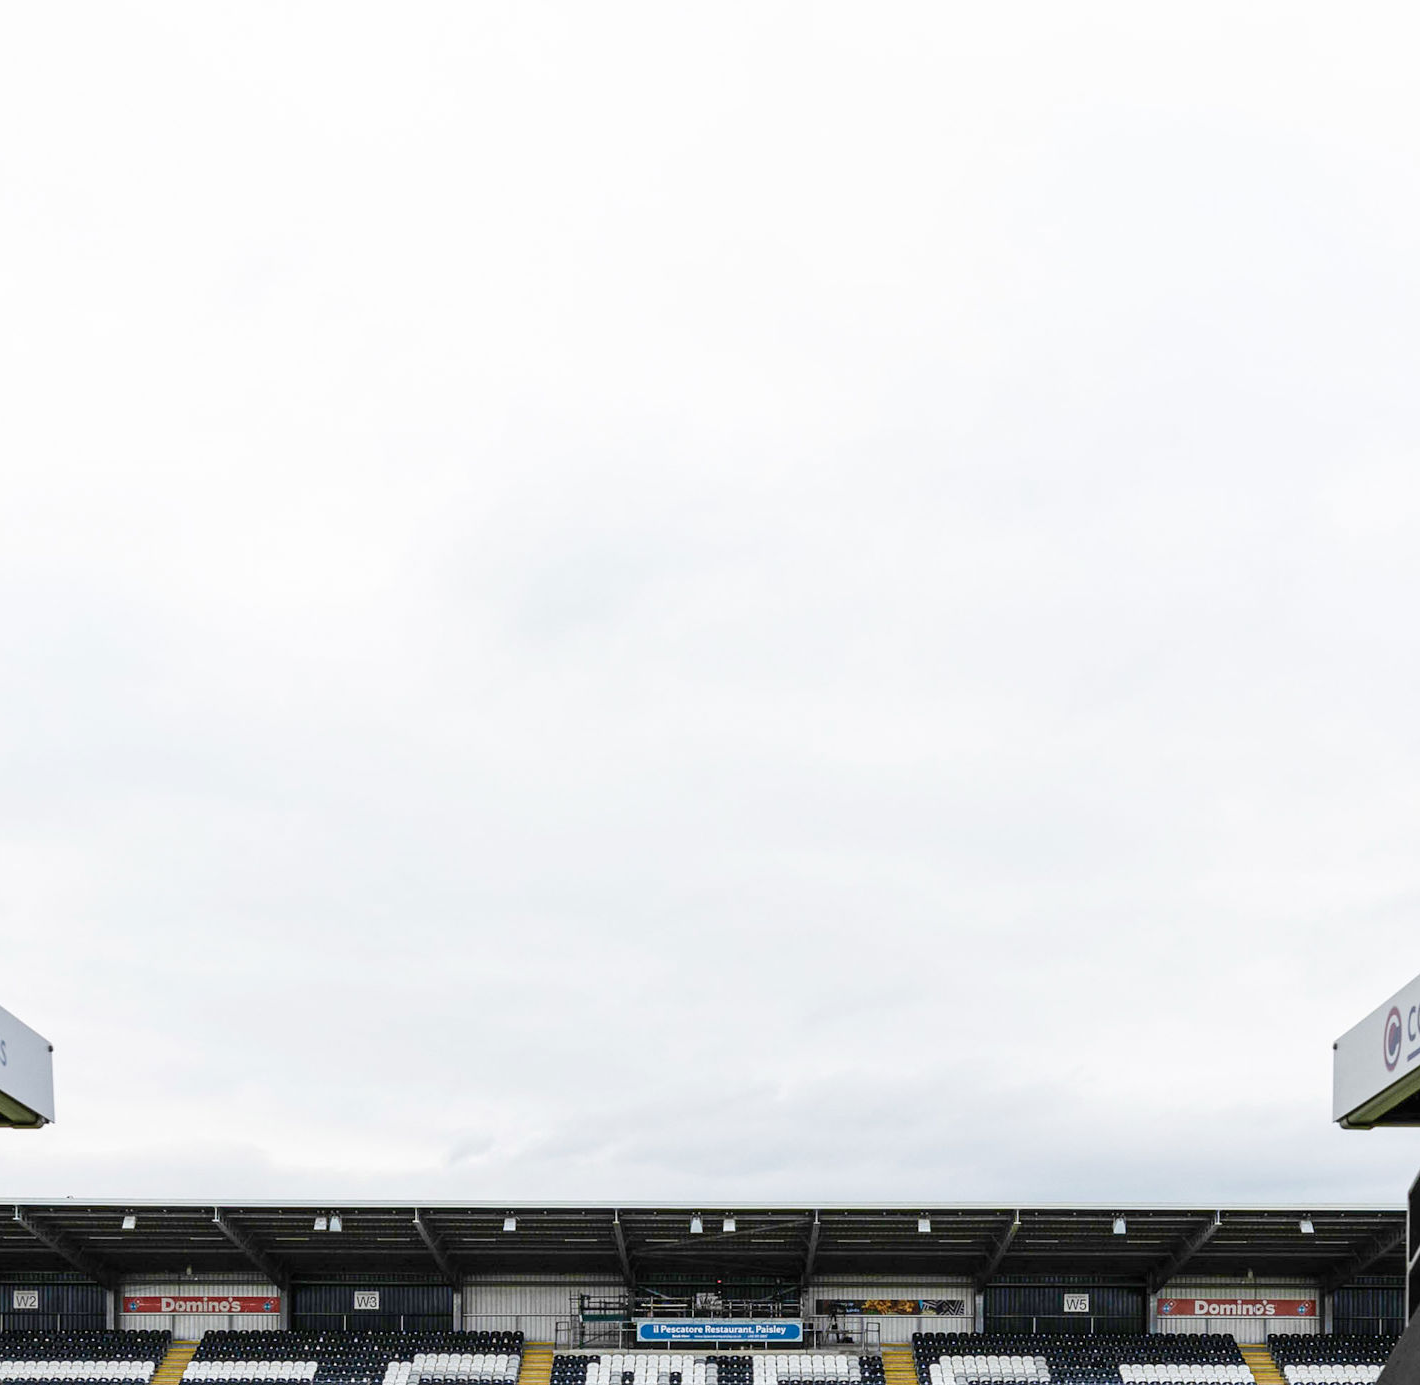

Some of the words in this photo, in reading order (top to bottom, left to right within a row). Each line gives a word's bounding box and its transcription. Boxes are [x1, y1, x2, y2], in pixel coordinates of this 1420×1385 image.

[16, 1295, 37, 1307] W2
[161, 1297, 241, 1312] Domino's
[357, 1296, 377, 1308] W3
[1066, 1299, 1087, 1310] W5
[1194, 1299, 1276, 1315] Domino's
[660, 1325, 703, 1334] Pescatore
[755, 1325, 787, 1335] Paisley
